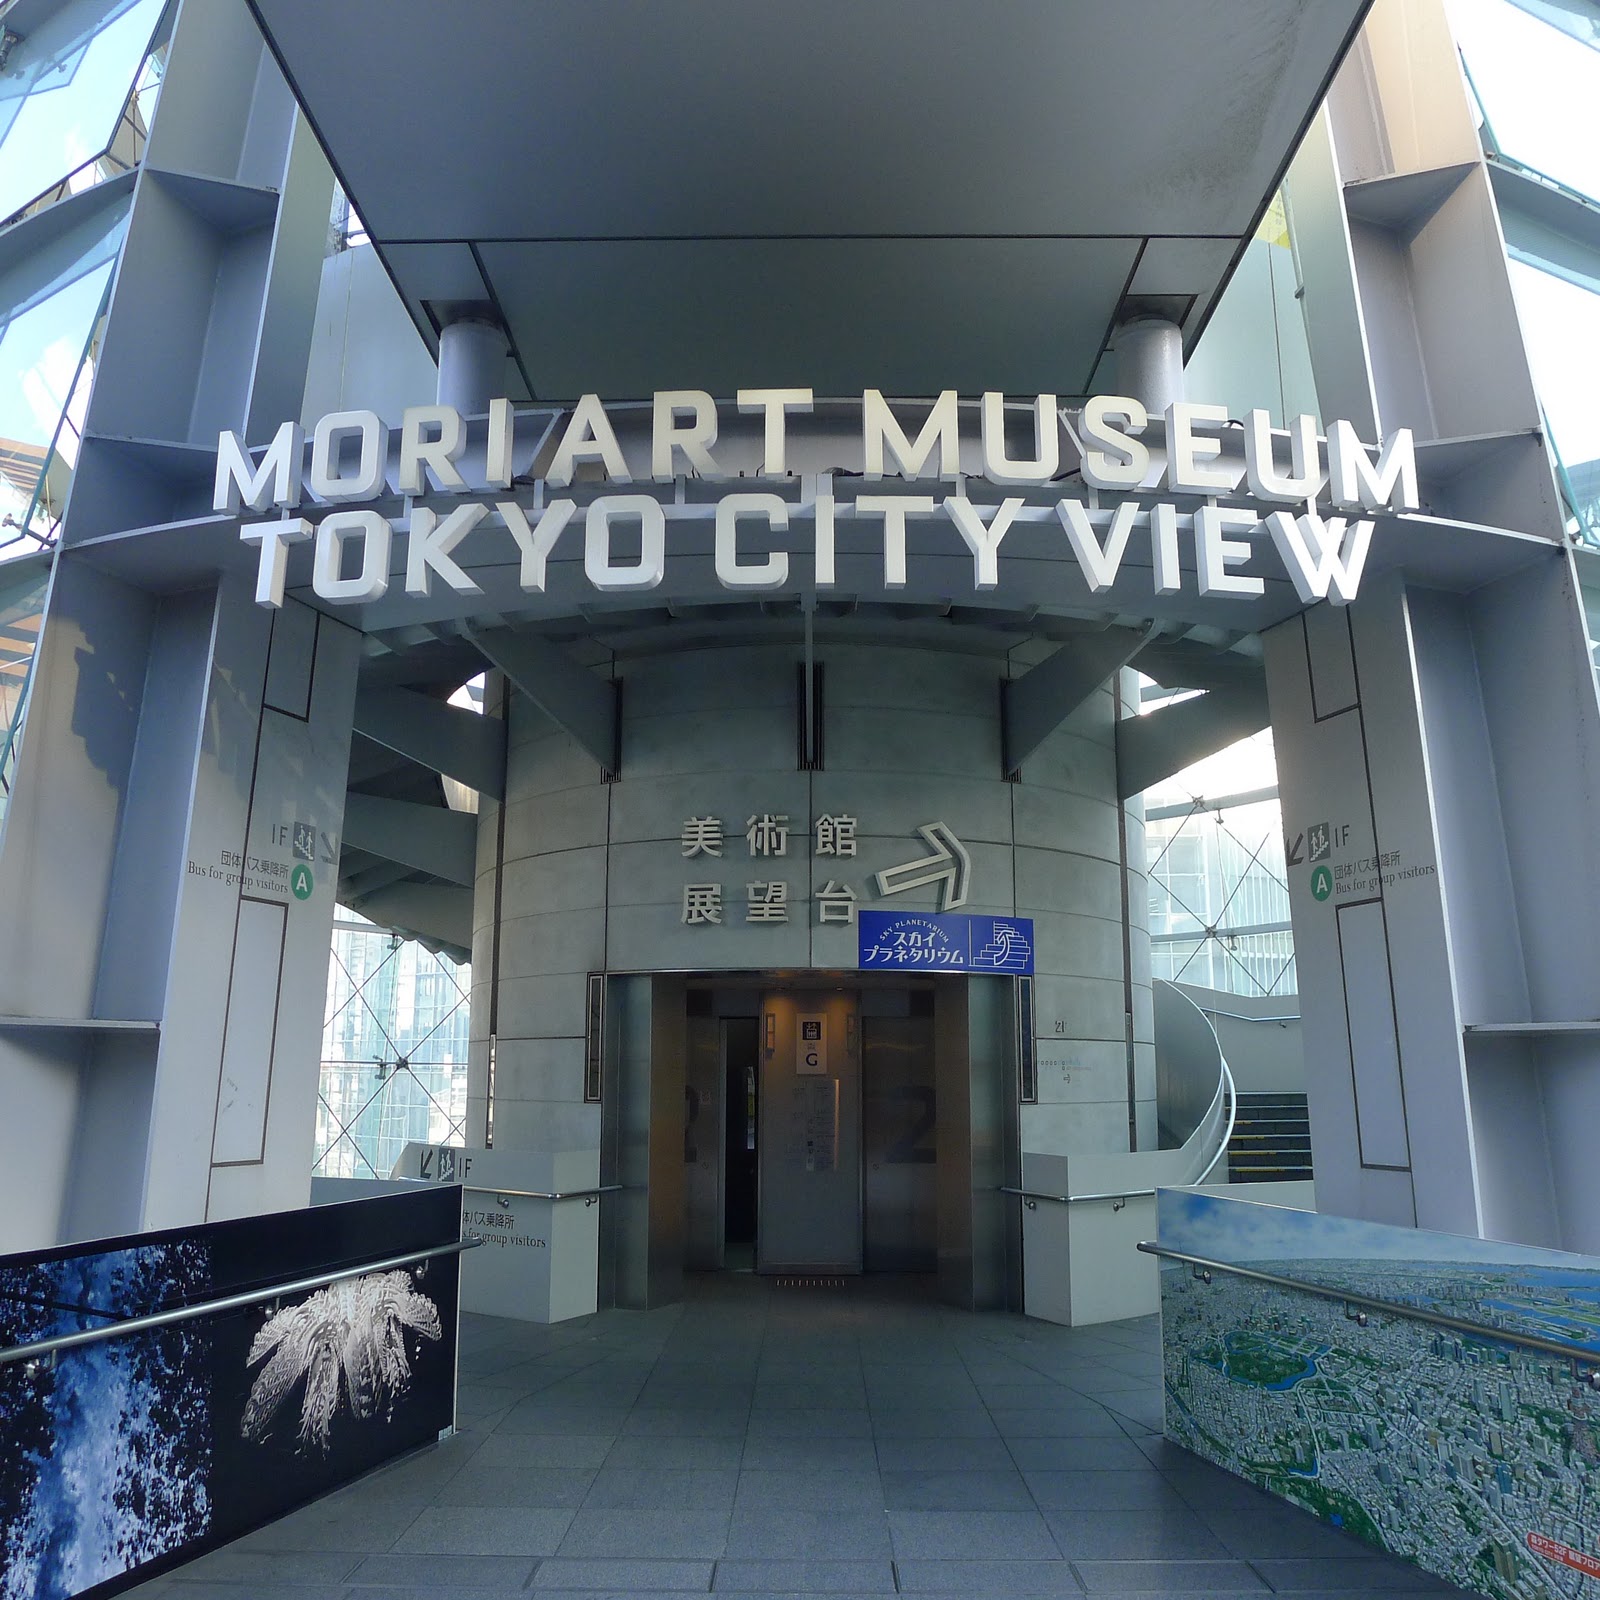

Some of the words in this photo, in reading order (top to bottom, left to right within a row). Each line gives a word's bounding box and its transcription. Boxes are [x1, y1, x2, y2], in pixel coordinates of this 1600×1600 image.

[213, 397, 514, 516] MORI
[546, 388, 813, 487] ART
[863, 389, 1420, 516] MUSEUM
[240, 494, 665, 609] TOKYO
[715, 493, 1025, 592] CITY
[1055, 498, 1375, 607] VIEW
[681, 813, 858, 858] 美術館
[188, 860, 206, 877] Bus
[209, 865, 224, 881] for
[226, 871, 253, 890] group
[256, 878, 288, 894] visitors
[1334, 850, 1400, 880] 団体バス乗降所
[296, 872, 308, 892] A
[1316, 873, 1328, 893] A
[1335, 881, 1351, 895] Bus
[1353, 877, 1366, 892] for
[1368, 873, 1396, 892] group
[1398, 864, 1435, 881] visitors
[680, 880, 858, 924] 展望台
[880, 926, 893, 941] SKY
[895, 919, 949, 943] PLANETARIUM
[893, 931, 936, 947] スカイ
[863, 944, 964, 964] プラネタリウム
[806, 1053, 818, 1067] G
[462, 1210, 515, 1230] 体バス乗降所
[482, 1233, 508, 1248] group
[510, 1234, 546, 1248] visitors
